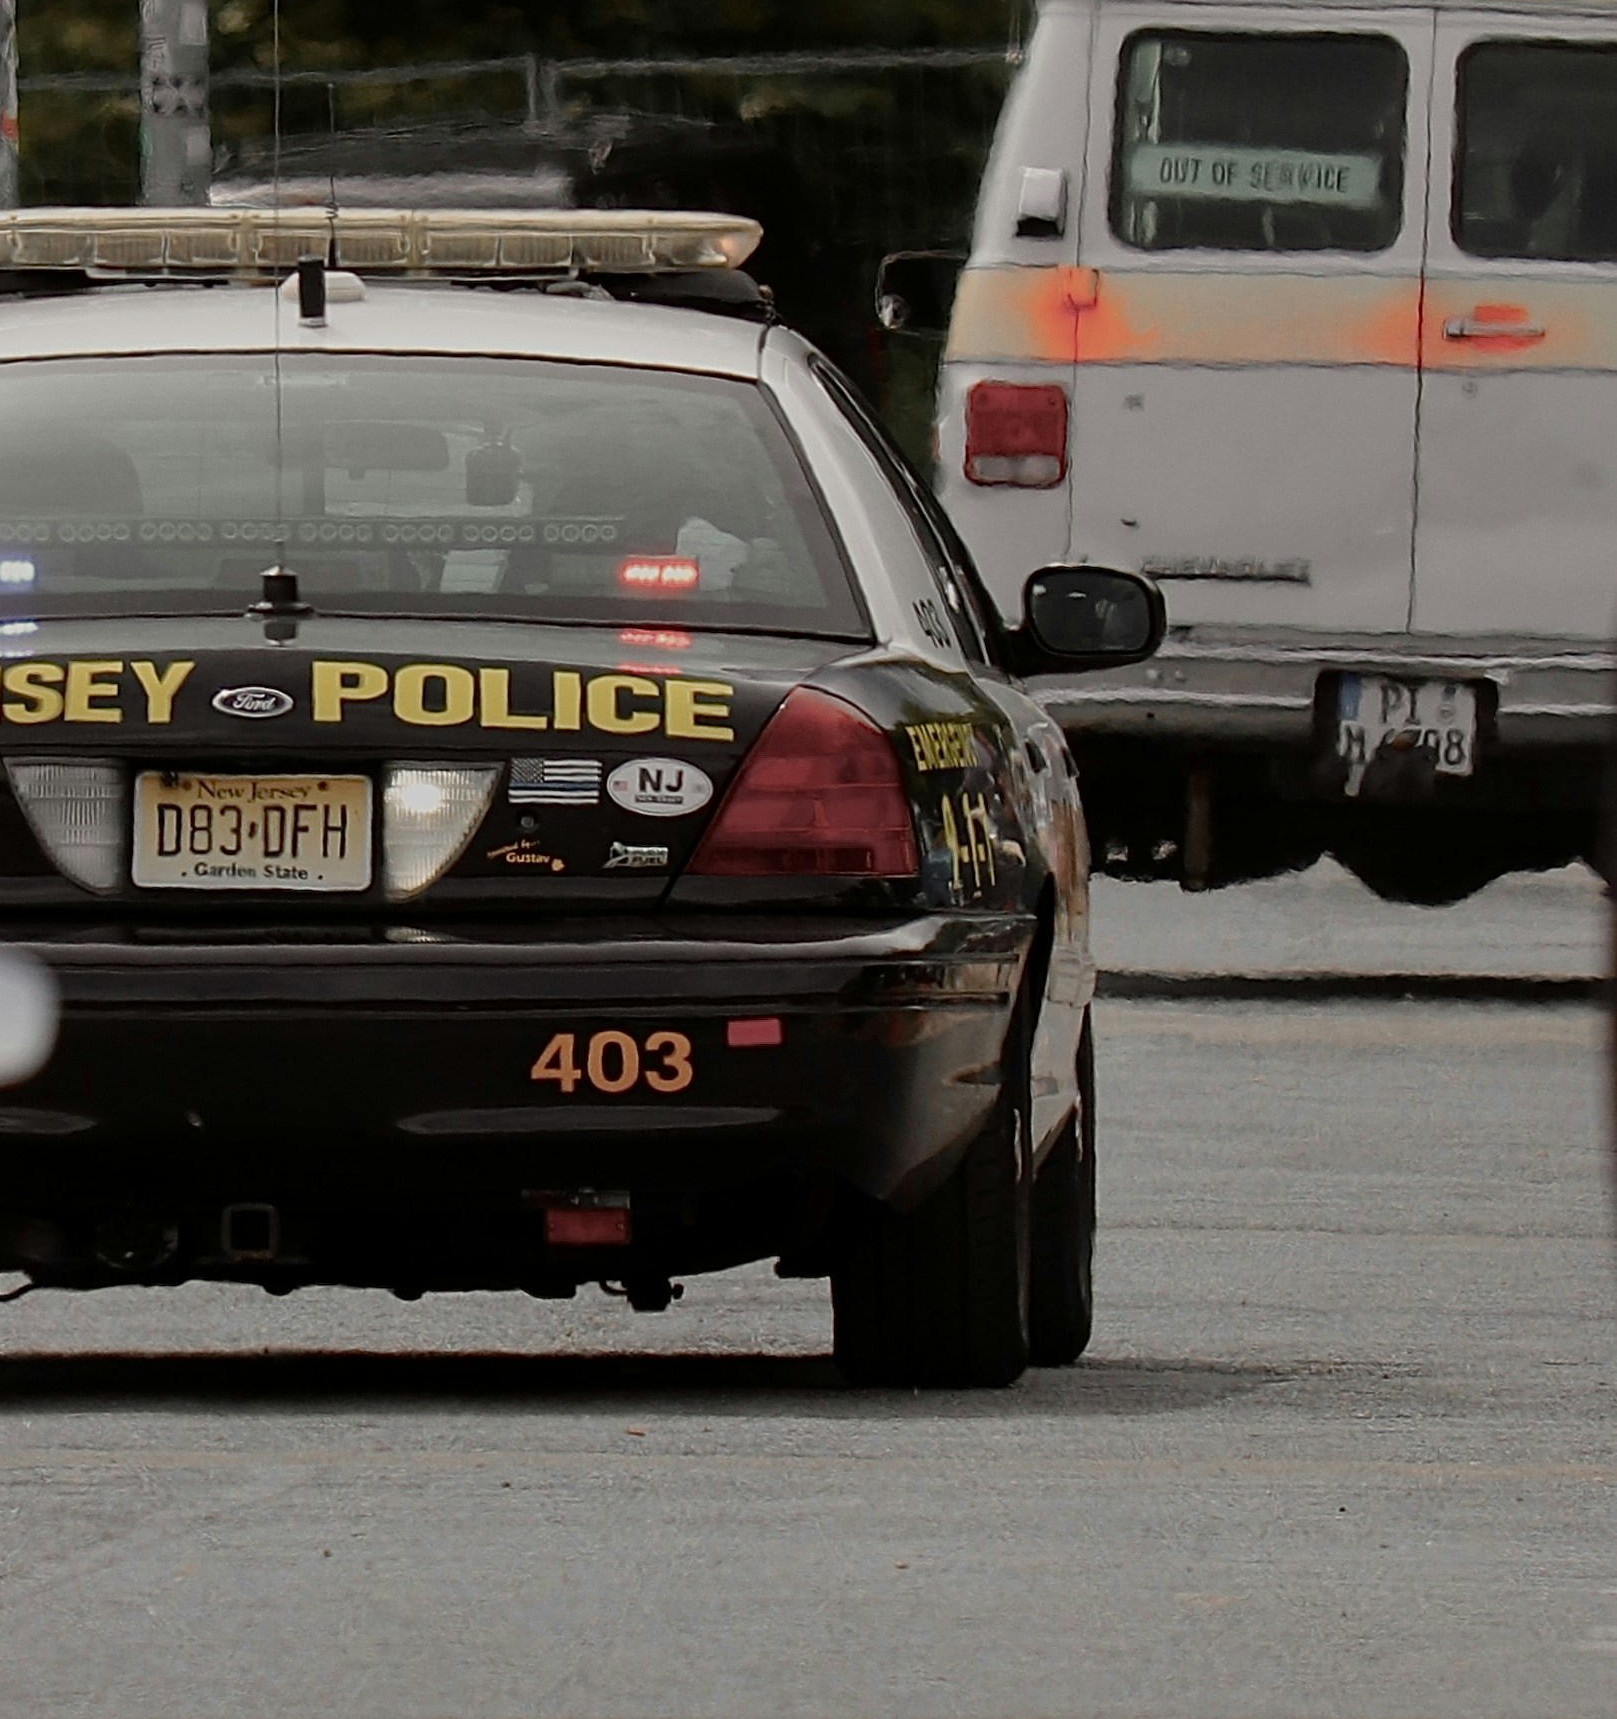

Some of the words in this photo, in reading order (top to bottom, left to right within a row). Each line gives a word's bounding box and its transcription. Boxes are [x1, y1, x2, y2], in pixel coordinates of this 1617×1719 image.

[1158, 156, 1204, 184] OUT
[1211, 160, 1240, 186] OF
[1249, 160, 1351, 193] SERVICE
[231, 689, 277, 716] Ford
[309, 658, 737, 744] POLICE
[196, 779, 245, 799] New
[246, 781, 313, 803] Jersey
[638, 767, 684, 793] NJ
[193, 861, 258, 879] Garden
[264, 863, 309, 880] State
[505, 851, 551, 864] Gustav
[528, 1027, 696, 1097] 403
